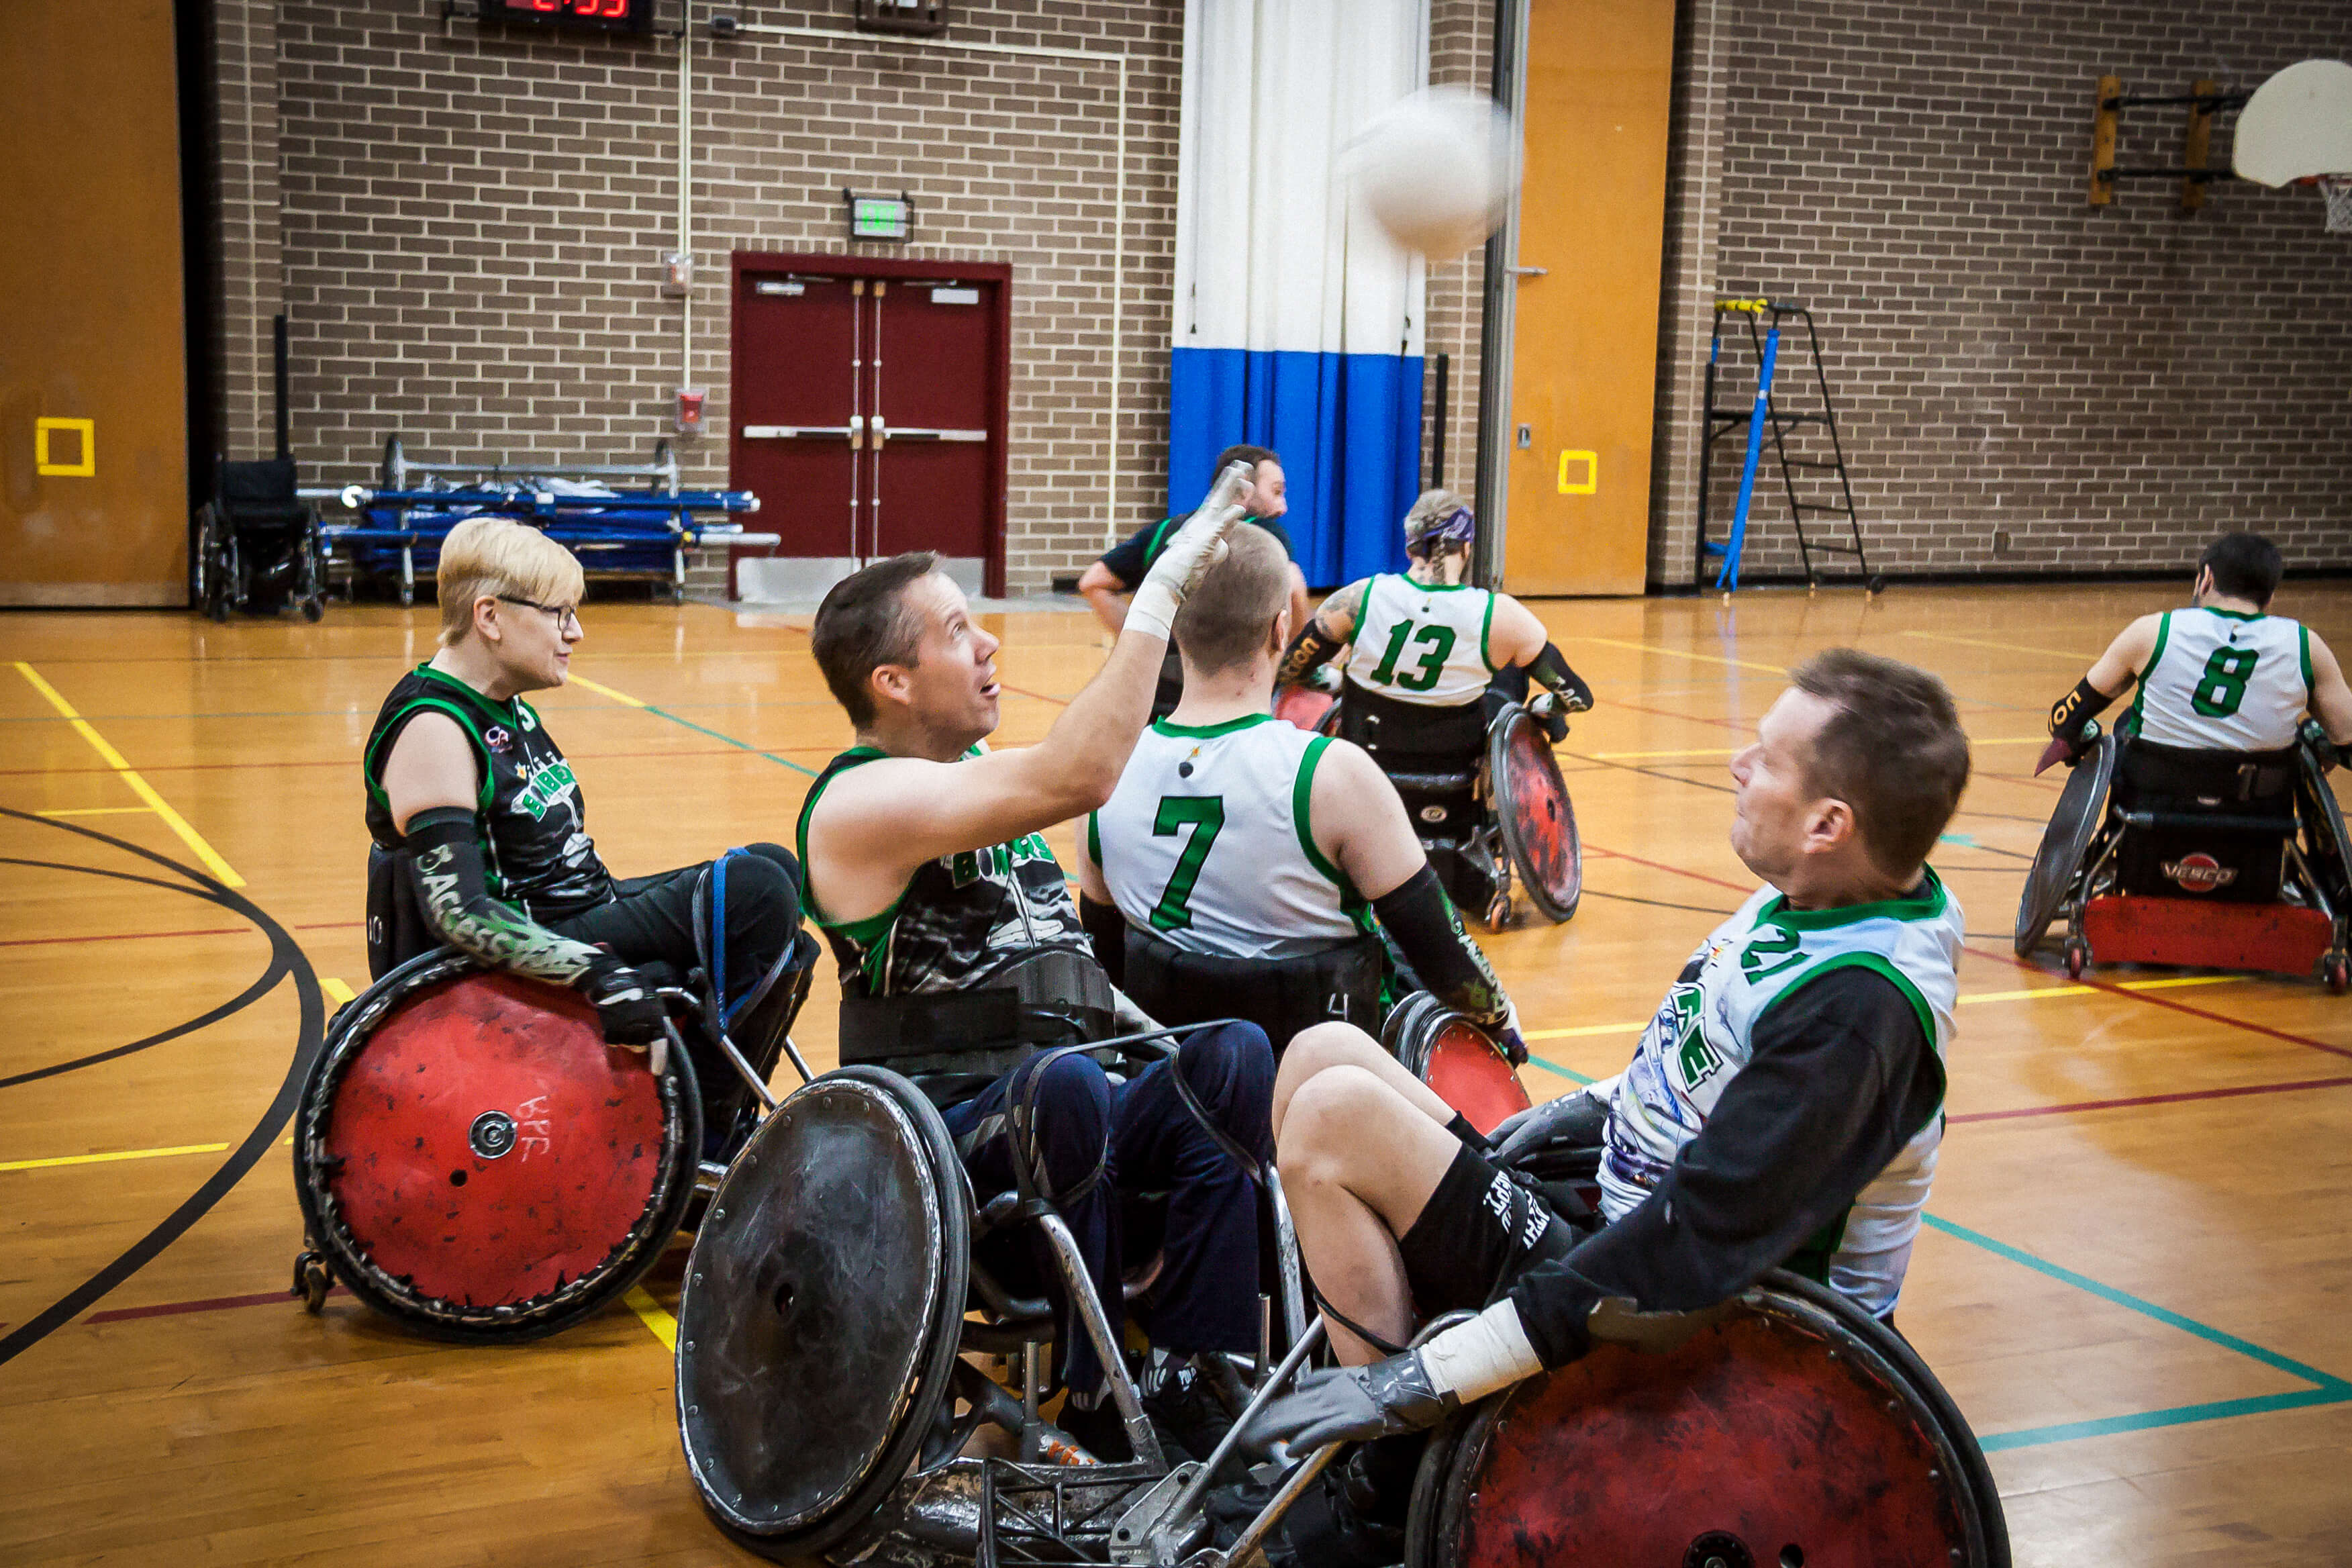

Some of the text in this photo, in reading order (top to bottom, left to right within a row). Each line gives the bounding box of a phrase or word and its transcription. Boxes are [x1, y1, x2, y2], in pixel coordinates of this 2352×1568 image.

[1369, 619, 1456, 691] 13
[2190, 646, 2259, 718] 8
[1149, 795, 1226, 930] 7
[1741, 928, 1813, 987] 21
[1326, 993, 1349, 1021] 4
